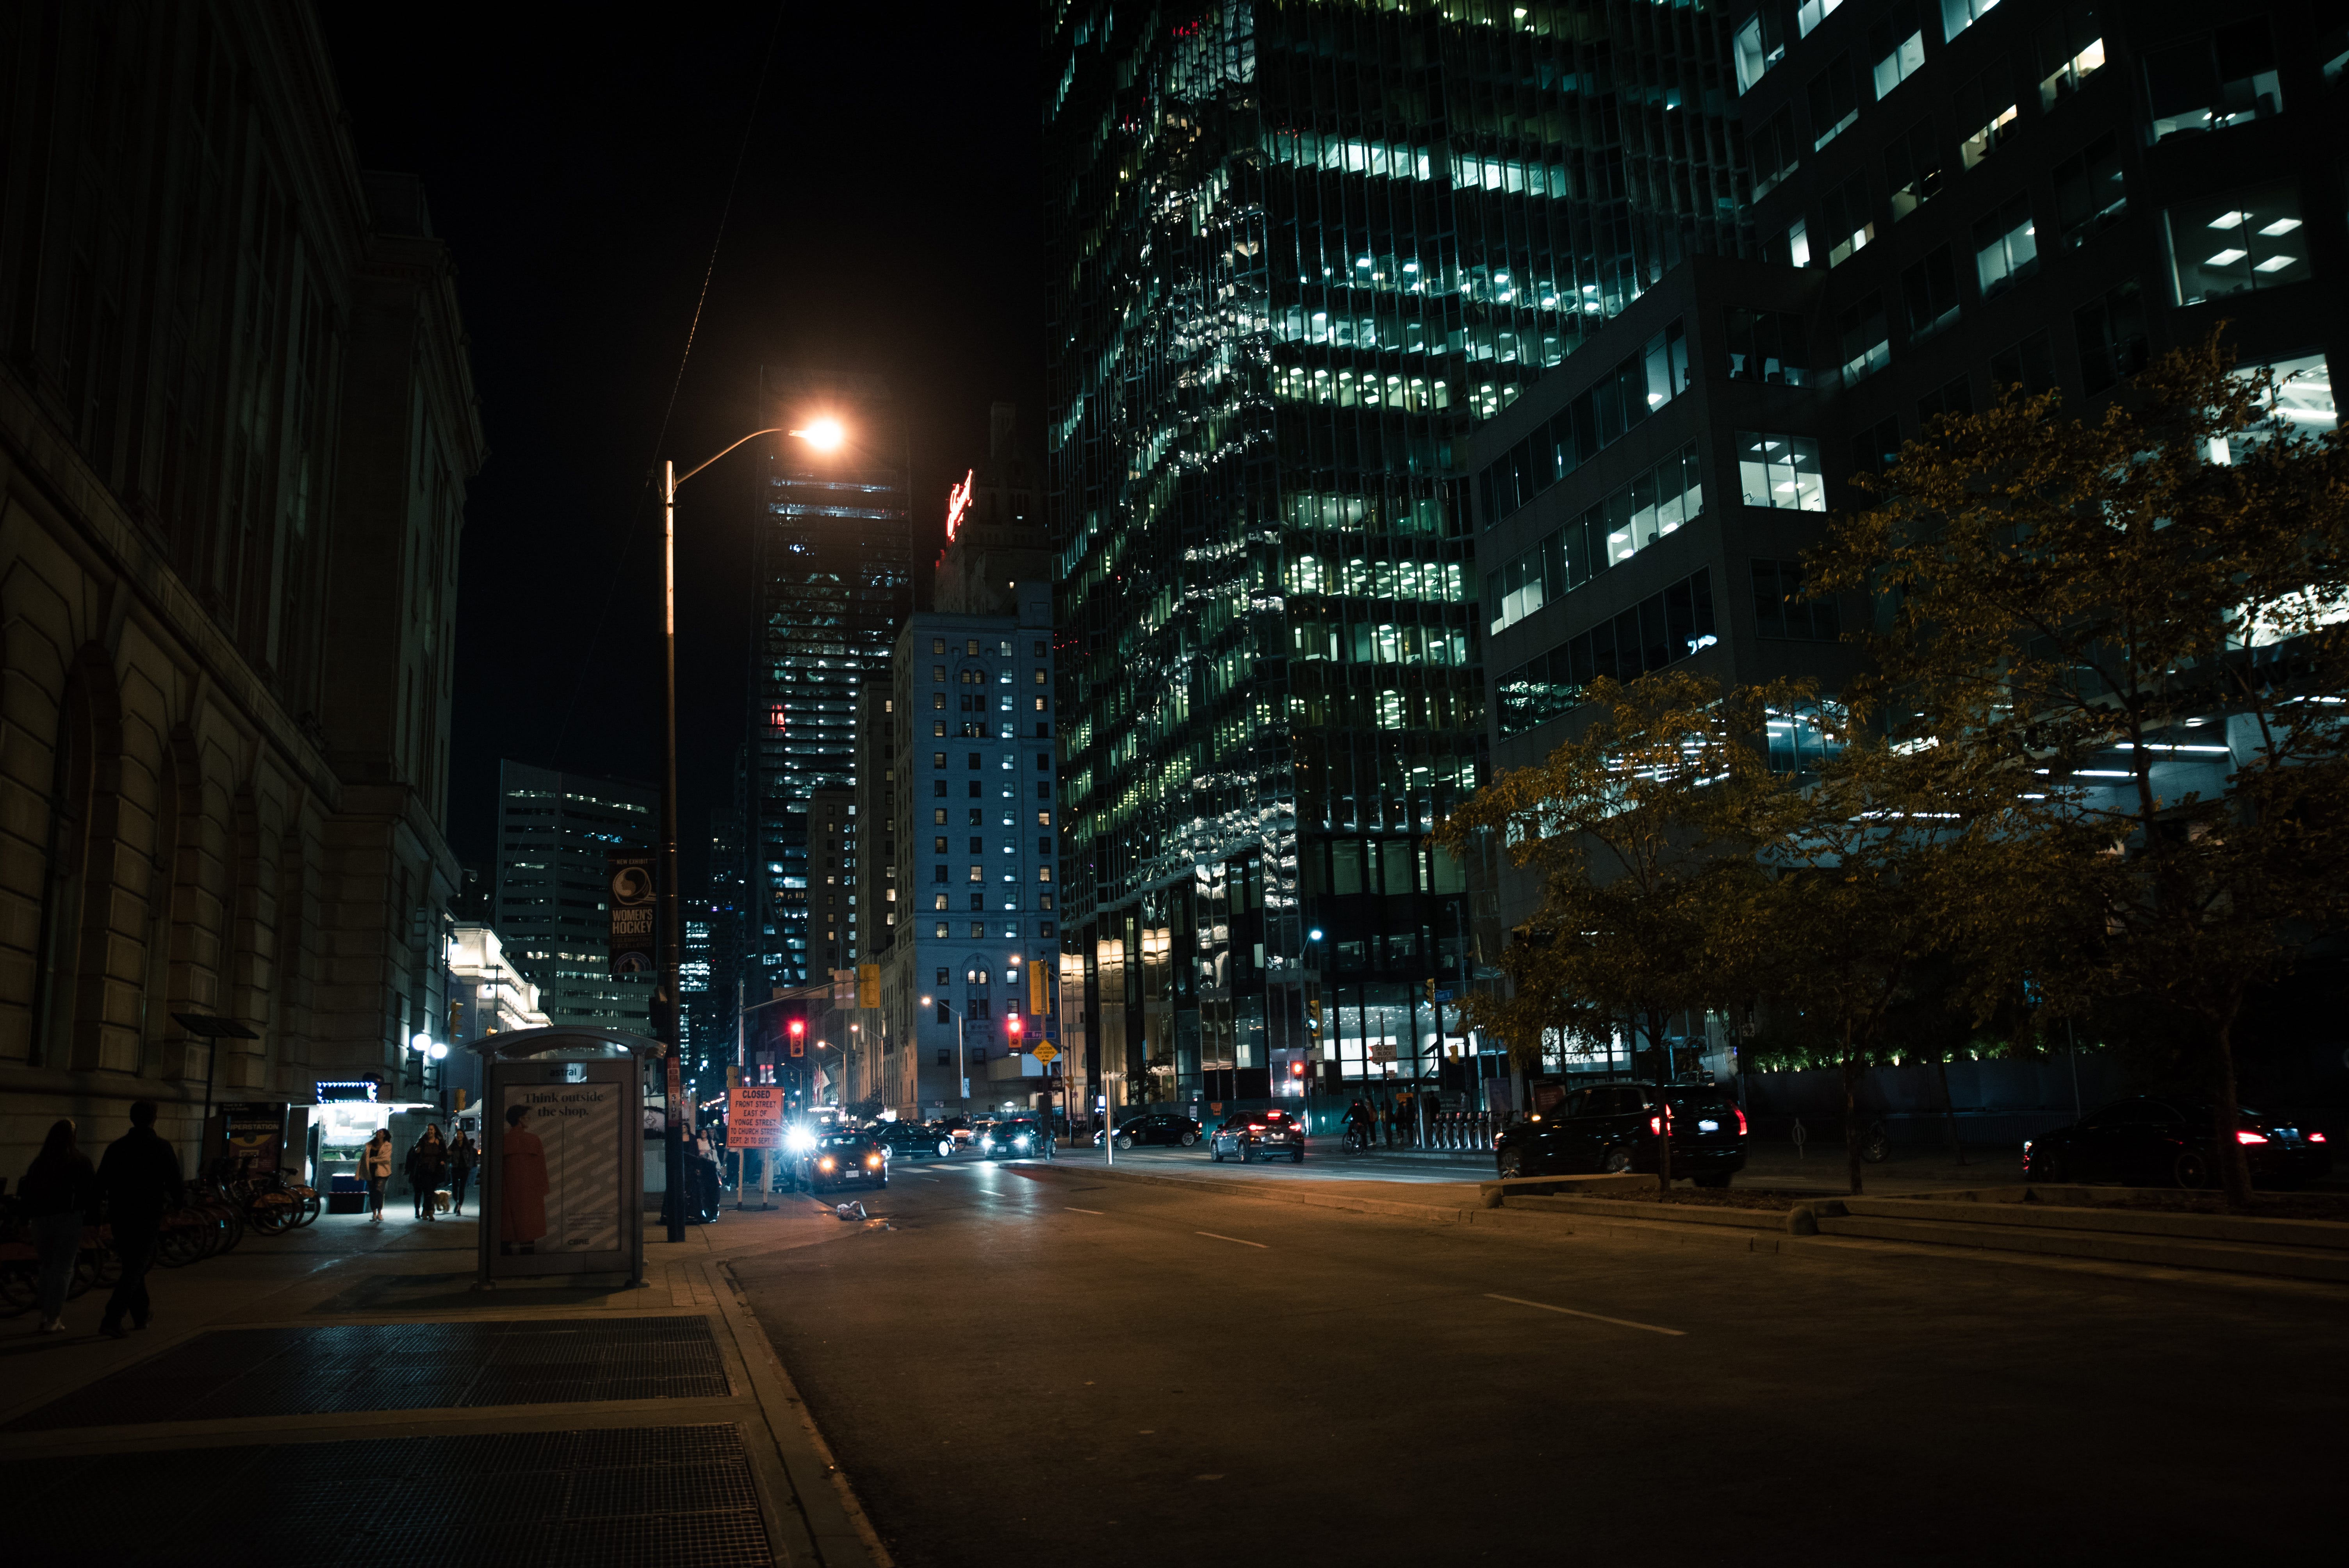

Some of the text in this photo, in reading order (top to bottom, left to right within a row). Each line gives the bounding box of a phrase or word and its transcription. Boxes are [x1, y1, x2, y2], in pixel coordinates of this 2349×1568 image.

[612, 909, 652, 921] WOMEN'S
[612, 920, 652, 934] HOCKEY
[549, 1068, 576, 1076] astral
[524, 1092, 604, 1103] Think outside
[743, 1090, 770, 1098] CLOSED
[538, 1106, 589, 1118] the shop.
